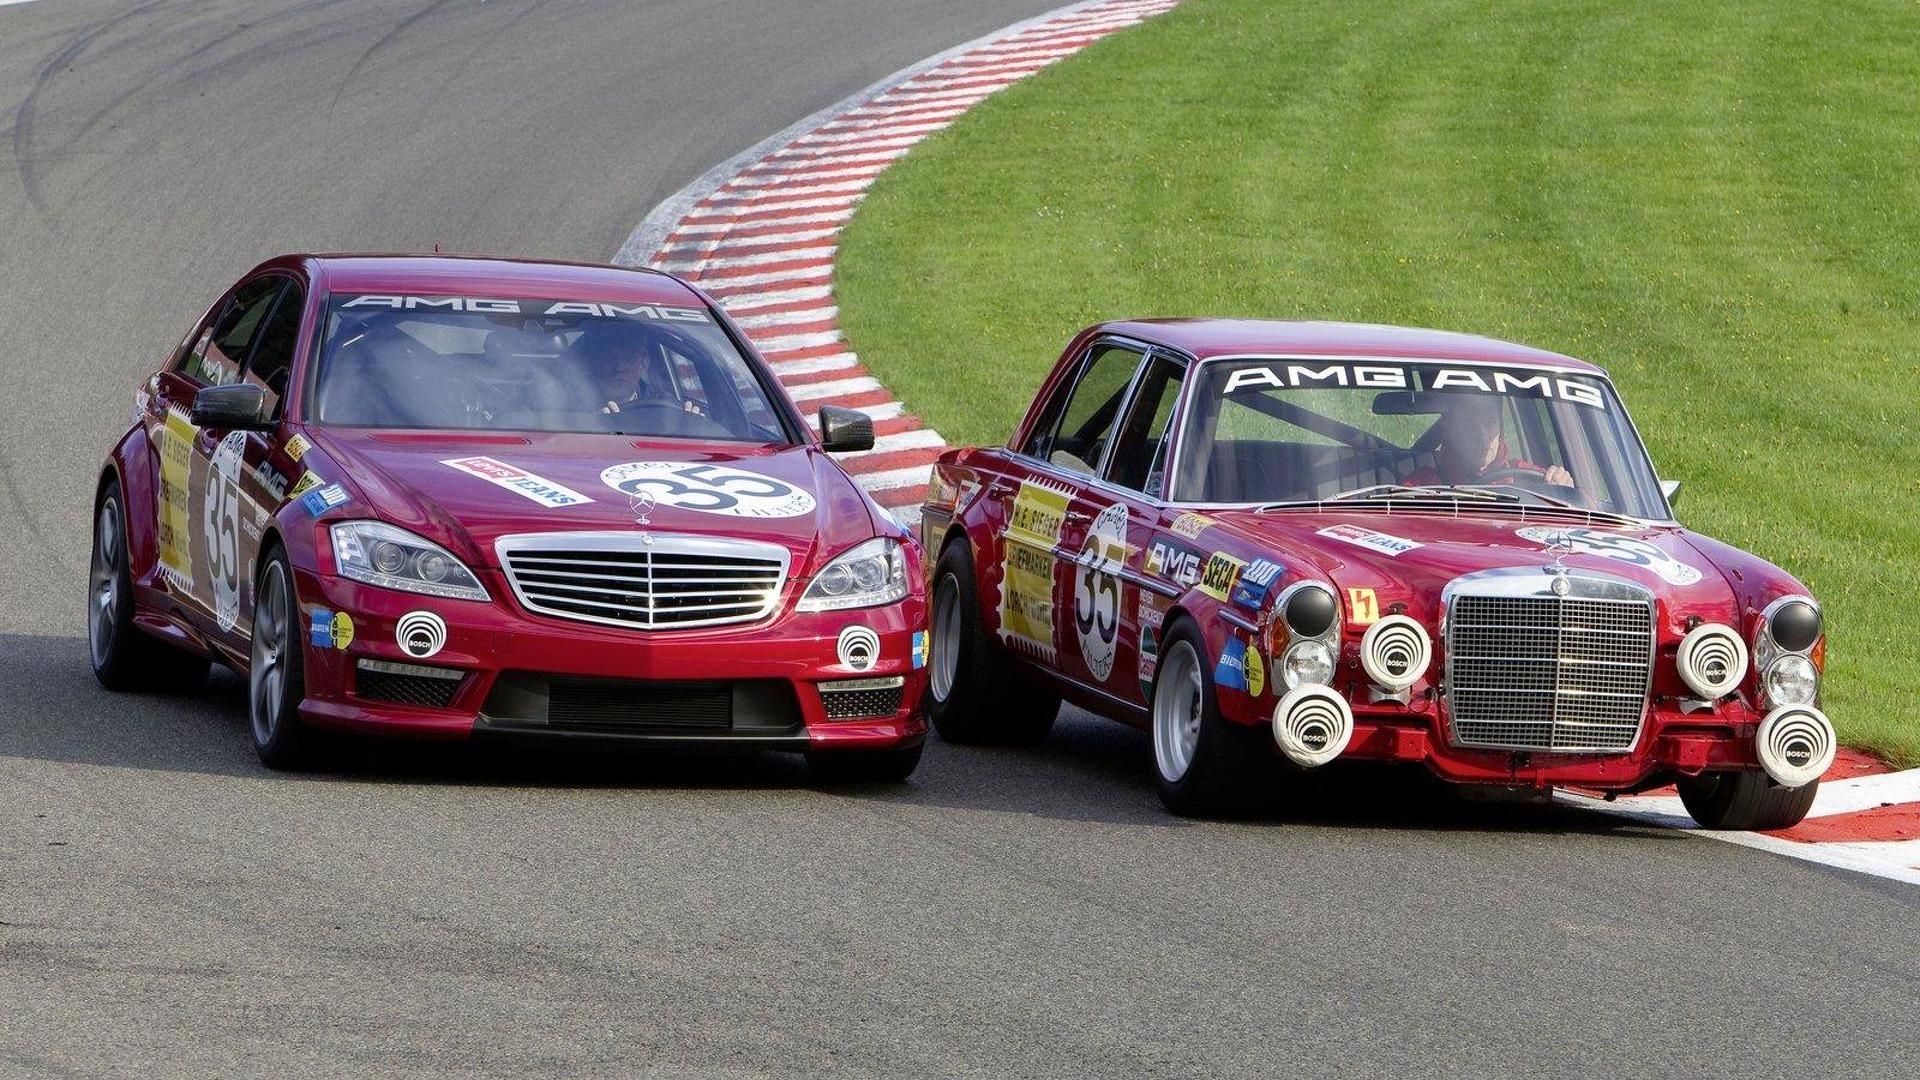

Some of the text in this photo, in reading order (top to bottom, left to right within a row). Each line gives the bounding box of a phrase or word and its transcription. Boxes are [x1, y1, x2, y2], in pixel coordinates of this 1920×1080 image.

[341, 295, 709, 323] AMG AMG
[1223, 365, 1604, 409] AMG AMG
[506, 477, 577, 504] JEANS
[618, 465, 792, 510] 35
[206, 461, 239, 592] 35
[1030, 509, 1061, 538] SIEGER
[1547, 529, 1669, 565] 35
[1147, 542, 1201, 585] AMG
[1203, 555, 1236, 592] SECA
[1075, 535, 1124, 644] 35
[409, 640, 431, 649] BOSCH
[1387, 659, 1409, 668] BOSCH
[1303, 733, 1328, 743] BOSCH
[1786, 750, 1811, 759] BOSCH
